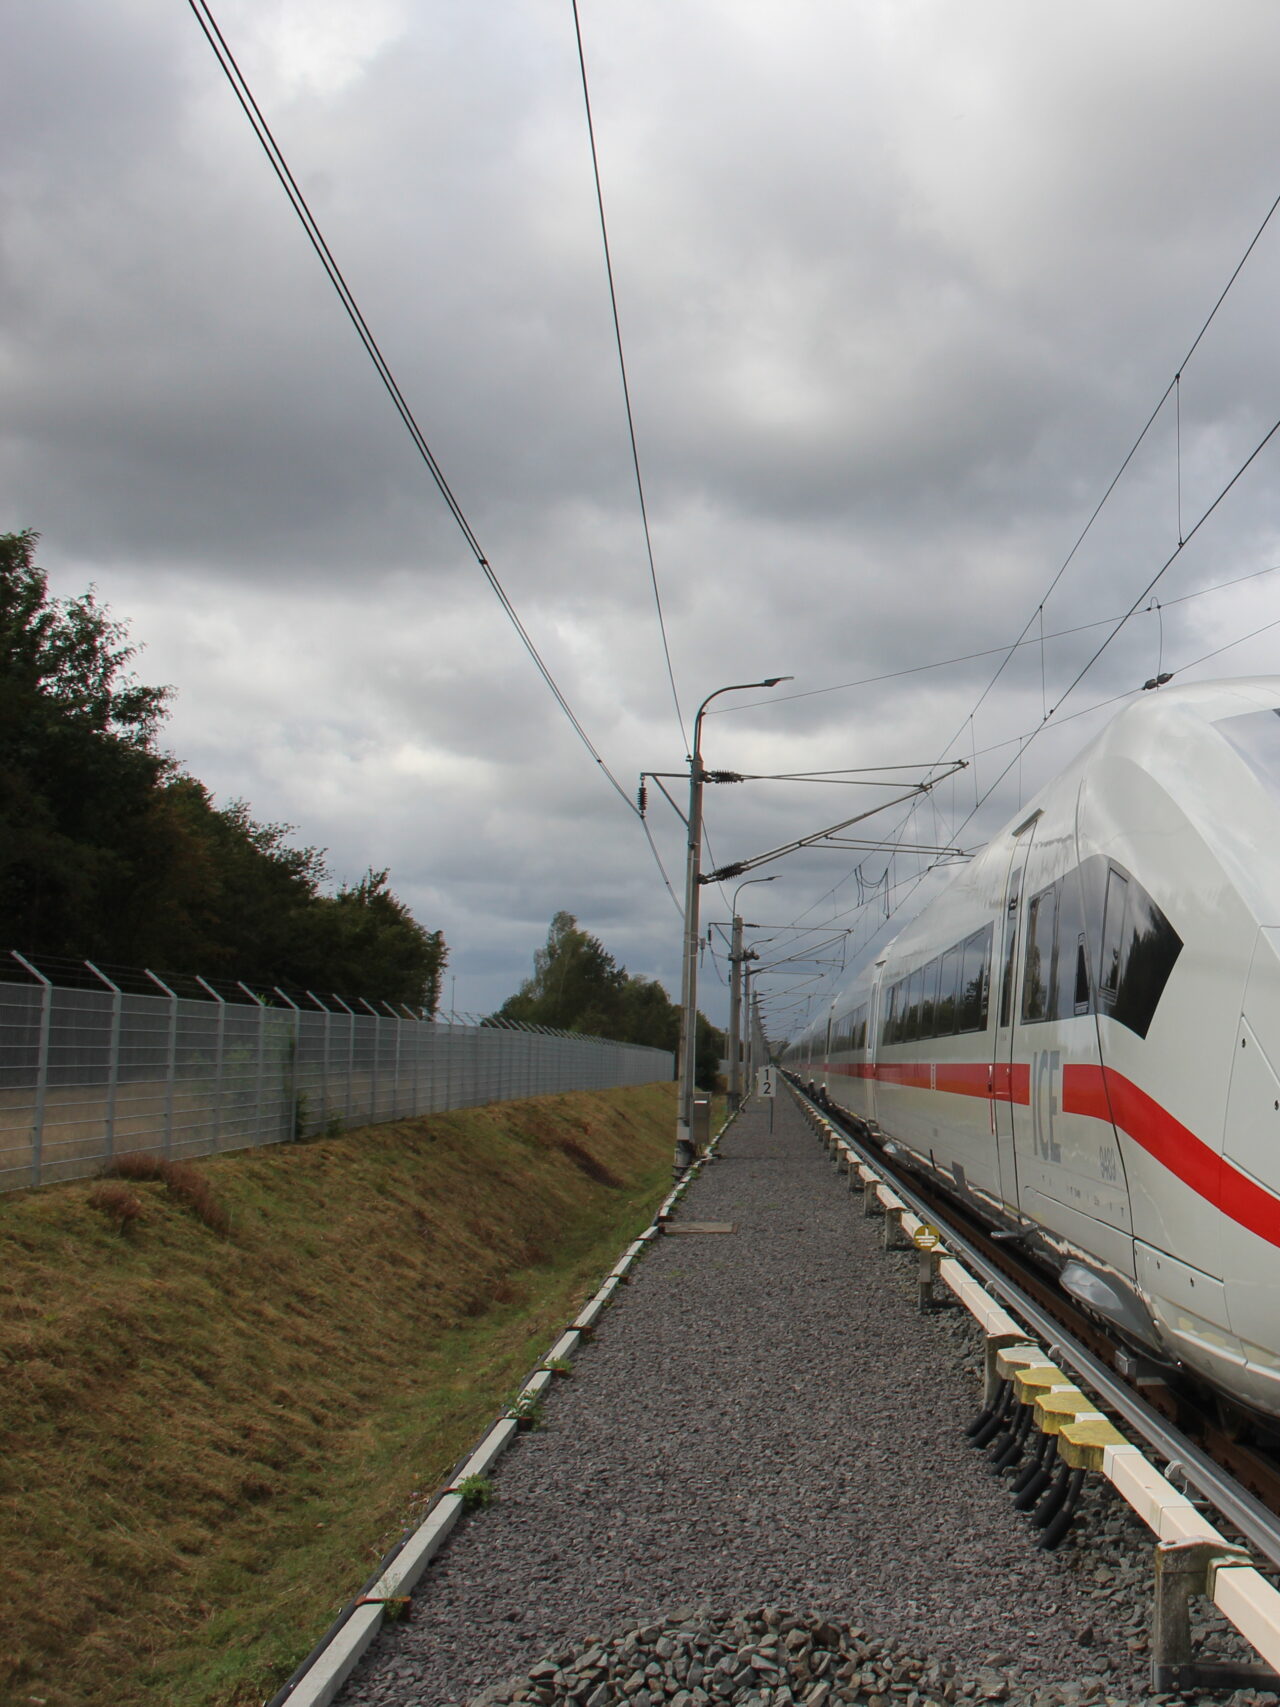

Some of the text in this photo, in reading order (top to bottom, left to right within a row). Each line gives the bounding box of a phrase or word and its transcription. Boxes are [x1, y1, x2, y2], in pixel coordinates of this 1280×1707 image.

[765, 1069, 769, 1081] 1
[763, 1082, 771, 1094] 2
[1033, 1049, 1061, 1163] ICE
